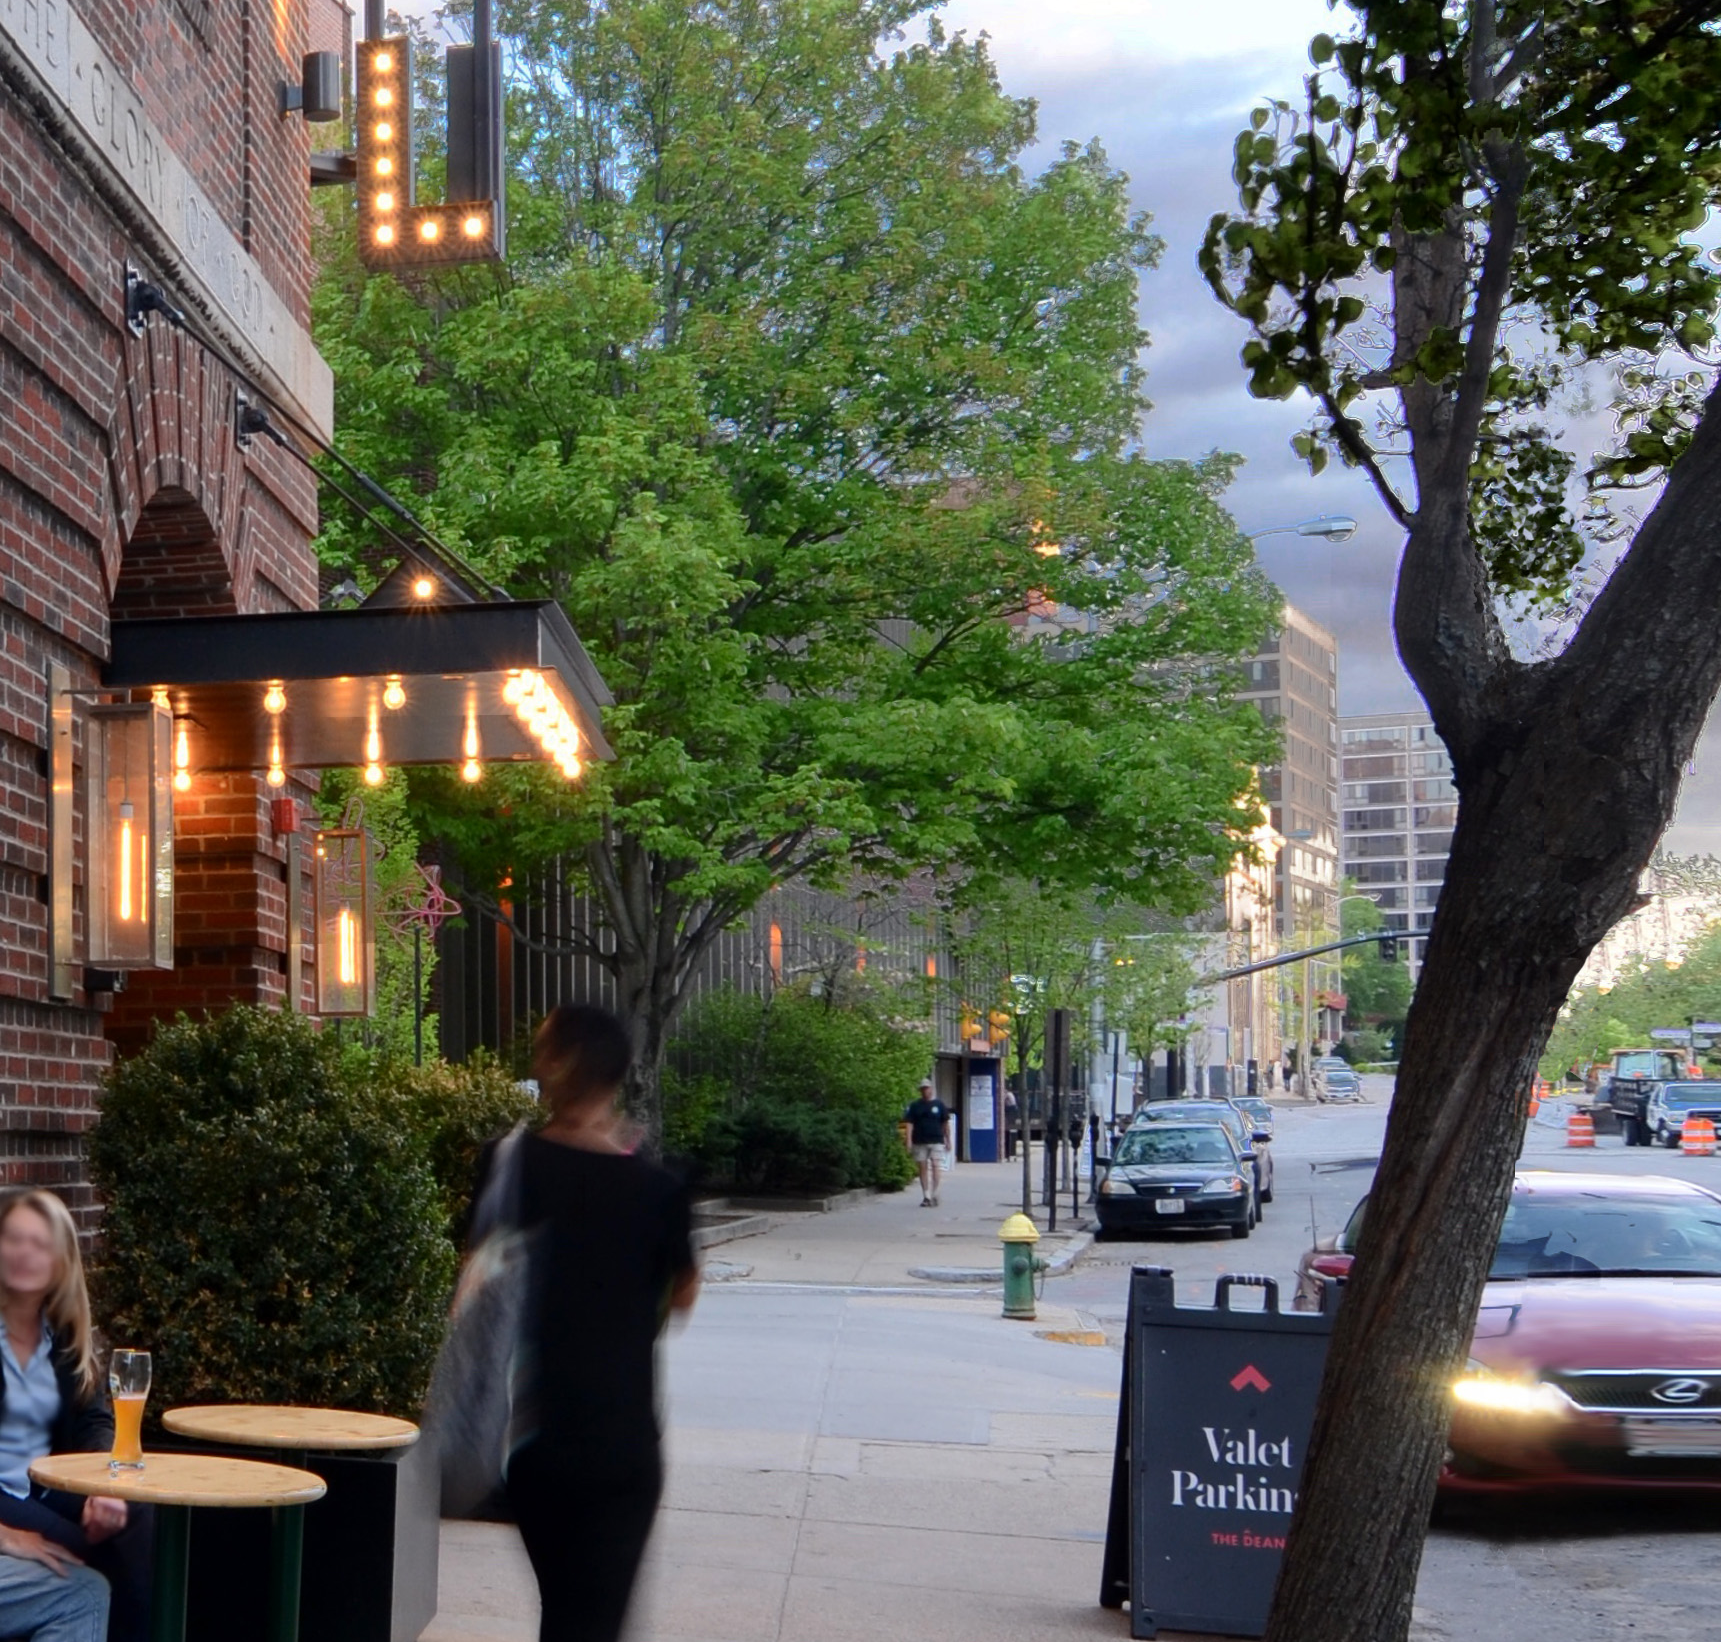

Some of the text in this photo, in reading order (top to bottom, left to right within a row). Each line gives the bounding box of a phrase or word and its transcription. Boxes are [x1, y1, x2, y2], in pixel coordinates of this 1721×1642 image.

[91, 62, 168, 210] GLORY
[185, 195, 210, 266] OF
[1201, 1426, 1293, 1469] Valet
[1171, 1469, 1299, 1513] Parkin
[1211, 1532, 1287, 1550] THE DEAN
